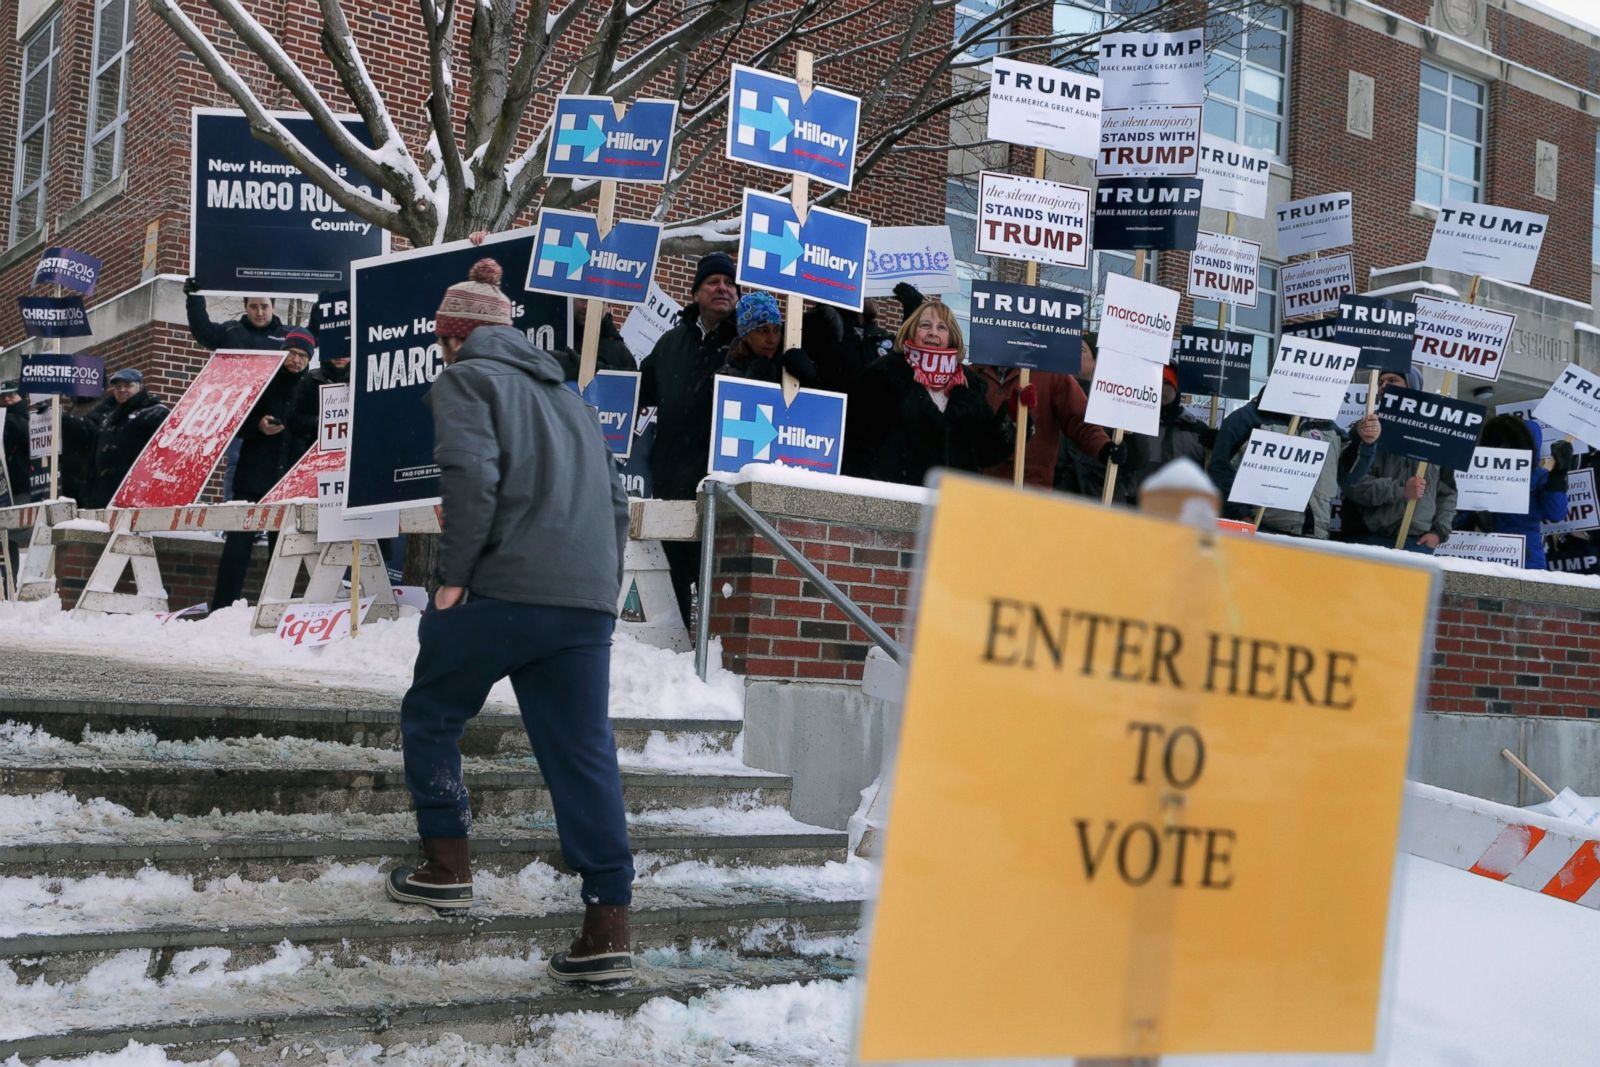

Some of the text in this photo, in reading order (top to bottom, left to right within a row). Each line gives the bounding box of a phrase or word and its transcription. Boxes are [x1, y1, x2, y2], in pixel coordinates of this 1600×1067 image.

[1102, 39, 1202, 58] TRUMP
[995, 69, 1101, 102] TRUMP
[992, 93, 1100, 119] MAKE AMERICA GREAT AGAIN!
[1101, 131, 1195, 143] STANDS WITH
[1102, 116, 1197, 133] the silent majority
[606, 131, 663, 156] Hillary
[793, 119, 849, 156] Hillary
[208, 158, 347, 177] New Hamps is
[1101, 146, 1194, 165] TRUMP
[1200, 146, 1269, 173] TRUMP
[207, 179, 293, 211] MARCO
[985, 184, 1085, 213] the silent majority
[1098, 187, 1201, 203] TRUMP
[984, 203, 1084, 228] STANDS WITH
[1116, 208, 1148, 216] AMERICA
[1149, 208, 1171, 216] GREAT
[1172, 208, 1199, 217] AGAIN!
[1277, 198, 1350, 222] TRUMP
[1441, 208, 1544, 237] TRUMP
[311, 218, 372, 236] Country
[984, 219, 1083, 253] TRUMP
[1435, 228, 1538, 251] MAKE AMERICA GREAT AGAIN!
[803, 243, 858, 279] Hillary
[1208, 242, 1229, 255] silent
[589, 250, 647, 279] Hillary
[1194, 255, 1255, 276] STANDS WITH
[1193, 269, 1254, 295] TRUMP
[1285, 273, 1349, 293] STANDS WITH
[973, 291, 1082, 320] TRUMP
[1286, 284, 1350, 309] TRUMP
[648, 295, 681, 327] RUM
[1106, 304, 1172, 333] marcorubio
[1339, 303, 1416, 327] TRUMP
[1431, 308, 1460, 323] silent
[1462, 315, 1507, 334] majority
[320, 320, 351, 330] MAKE AMER
[368, 323, 408, 343] New
[971, 316, 1081, 337] MAKE AMERICA GREAT AGAIN!
[1337, 325, 1354, 333] MAKE
[1354, 327, 1381, 337] AMERICA
[1381, 330, 1396, 338] GREAT
[1413, 320, 1503, 347] STANDS WITH
[1182, 335, 1252, 357] TRUMP
[1412, 334, 1498, 367] TRUMP
[366, 343, 443, 392] MARC
[1195, 356, 1219, 365] AMERICA
[1280, 346, 1356, 372] TRUMP
[1273, 368, 1289, 377] MAKE
[1289, 371, 1314, 382] AMERICA
[1314, 375, 1333, 383] GREAT
[1563, 371, 1600, 401] TRU
[1096, 379, 1158, 404] marcorubio
[158, 384, 253, 456] Jeb!
[325, 408, 349, 419] STAN
[1383, 392, 1483, 427] TRUMP
[1378, 412, 1396, 423] MAKE
[1397, 416, 1427, 429] AMERICA
[1429, 424, 1451, 435] GREAT
[1451, 430, 1477, 442] AGAIN!
[777, 425, 834, 457] Hillary
[1250, 440, 1325, 466] TRUMP
[1242, 461, 1257, 470] MAKE
[1258, 464, 1283, 474] AMERICA
[1283, 467, 1300, 476] GREAT
[1474, 456, 1529, 471] UMP
[1452, 540, 1519, 558] silent majority
[1549, 555, 1598, 571] UMP
[281, 606, 352, 646] Jeb!
[980, 596, 1359, 711] ENTER HERE
[1127, 720, 1207, 790] TO
[1072, 817, 1238, 891] VOTE
